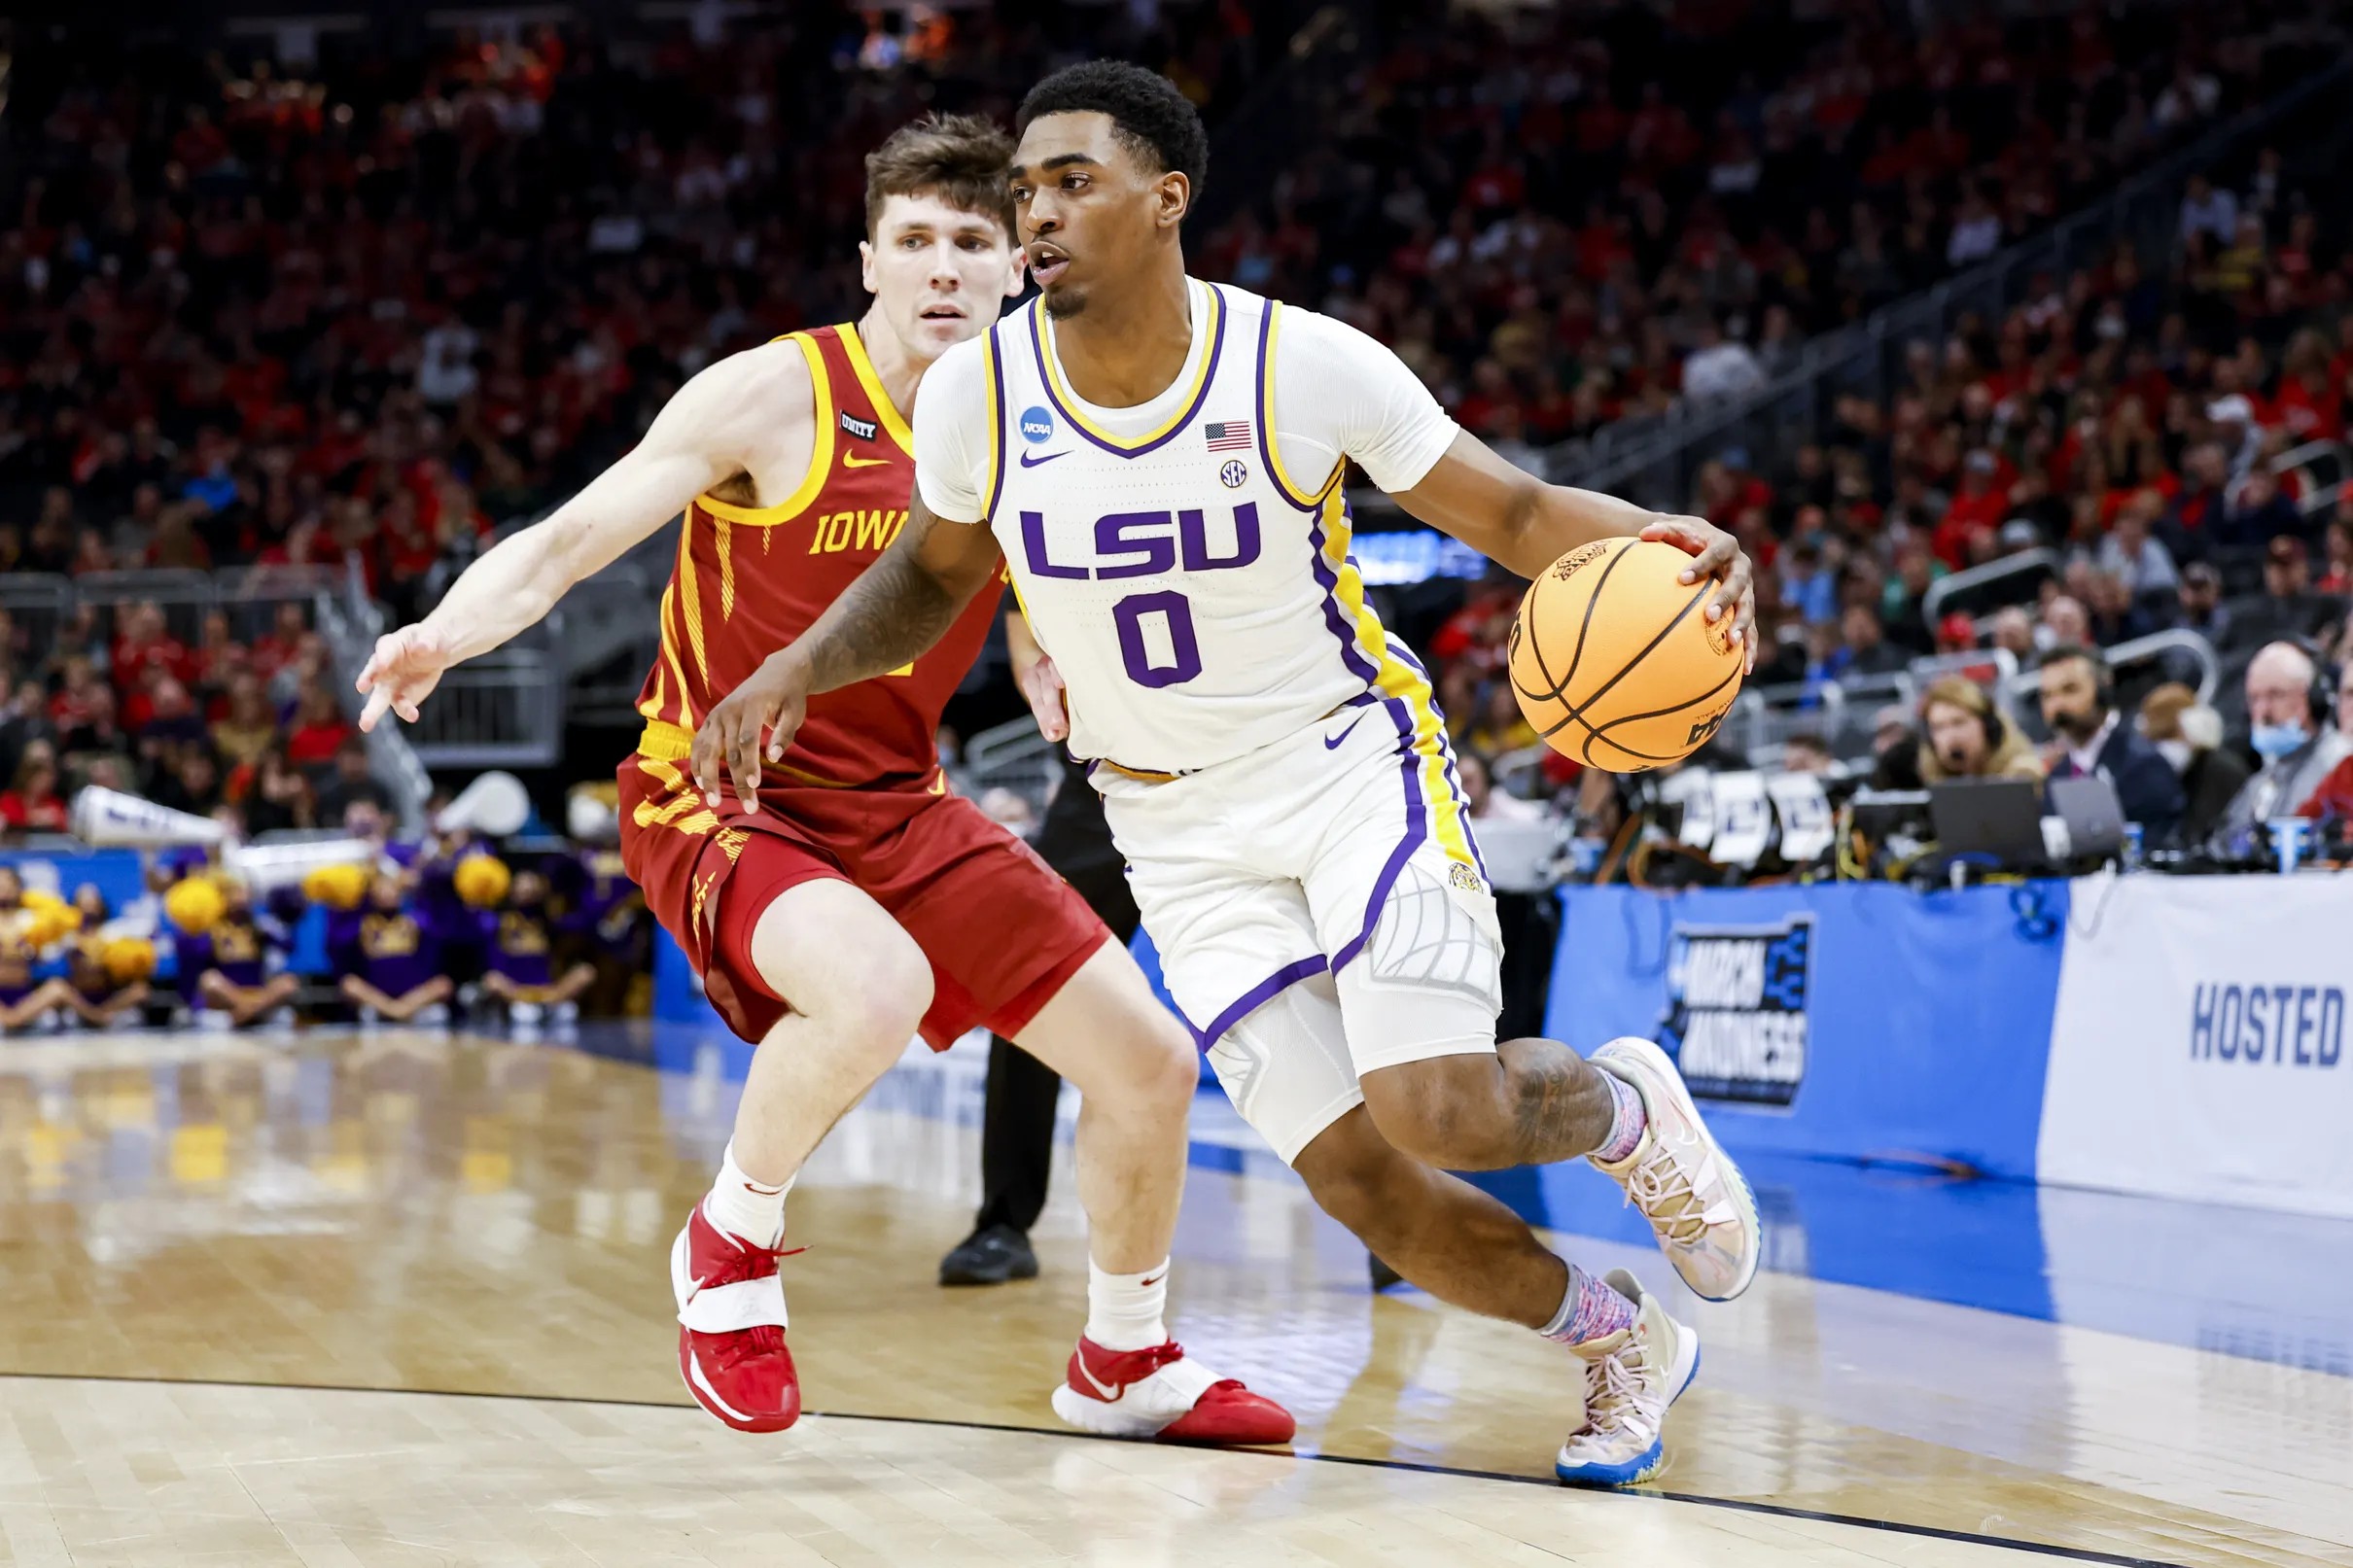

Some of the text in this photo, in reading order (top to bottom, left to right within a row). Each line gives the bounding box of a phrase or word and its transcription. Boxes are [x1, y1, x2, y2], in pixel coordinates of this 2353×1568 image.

[841, 412, 876, 438] UNITY
[1023, 422, 1051, 436] NCAA
[1221, 461, 1247, 487] SEC
[1019, 502, 1261, 580] LSU
[1112, 589, 1203, 689] 0
[2191, 983, 2344, 1066] HOSTED
